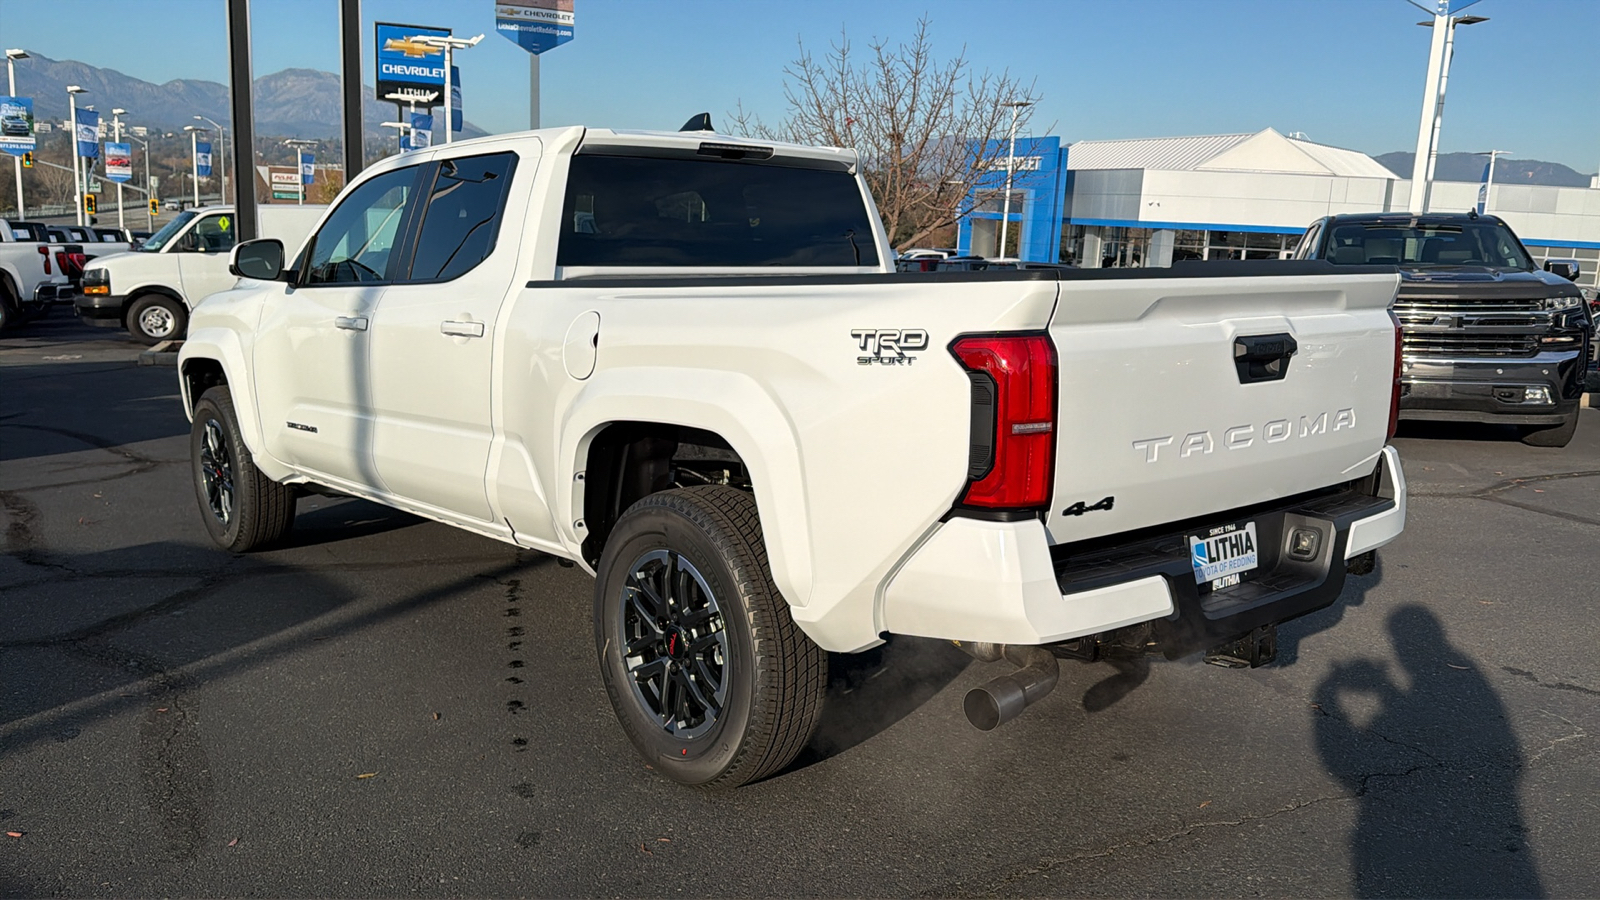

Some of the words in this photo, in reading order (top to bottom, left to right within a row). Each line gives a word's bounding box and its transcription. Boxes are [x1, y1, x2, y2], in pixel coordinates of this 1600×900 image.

[523, 10, 571, 20] CHEVROLET
[498, 22, 572, 37] LithiaChevroletRedding.com
[382, 63, 446, 78] CHEVROLET
[850, 328, 929, 358] TRD
[857, 356, 917, 366] SPORT
[1131, 407, 1356, 463] TACOMA
[1209, 525, 1224, 536] SINCE
[1206, 531, 1255, 564] LITHIA
[1195, 564, 1219, 579] TOYOTA
[1220, 561, 1228, 573] OF
[1229, 555, 1256, 570] REDDING
